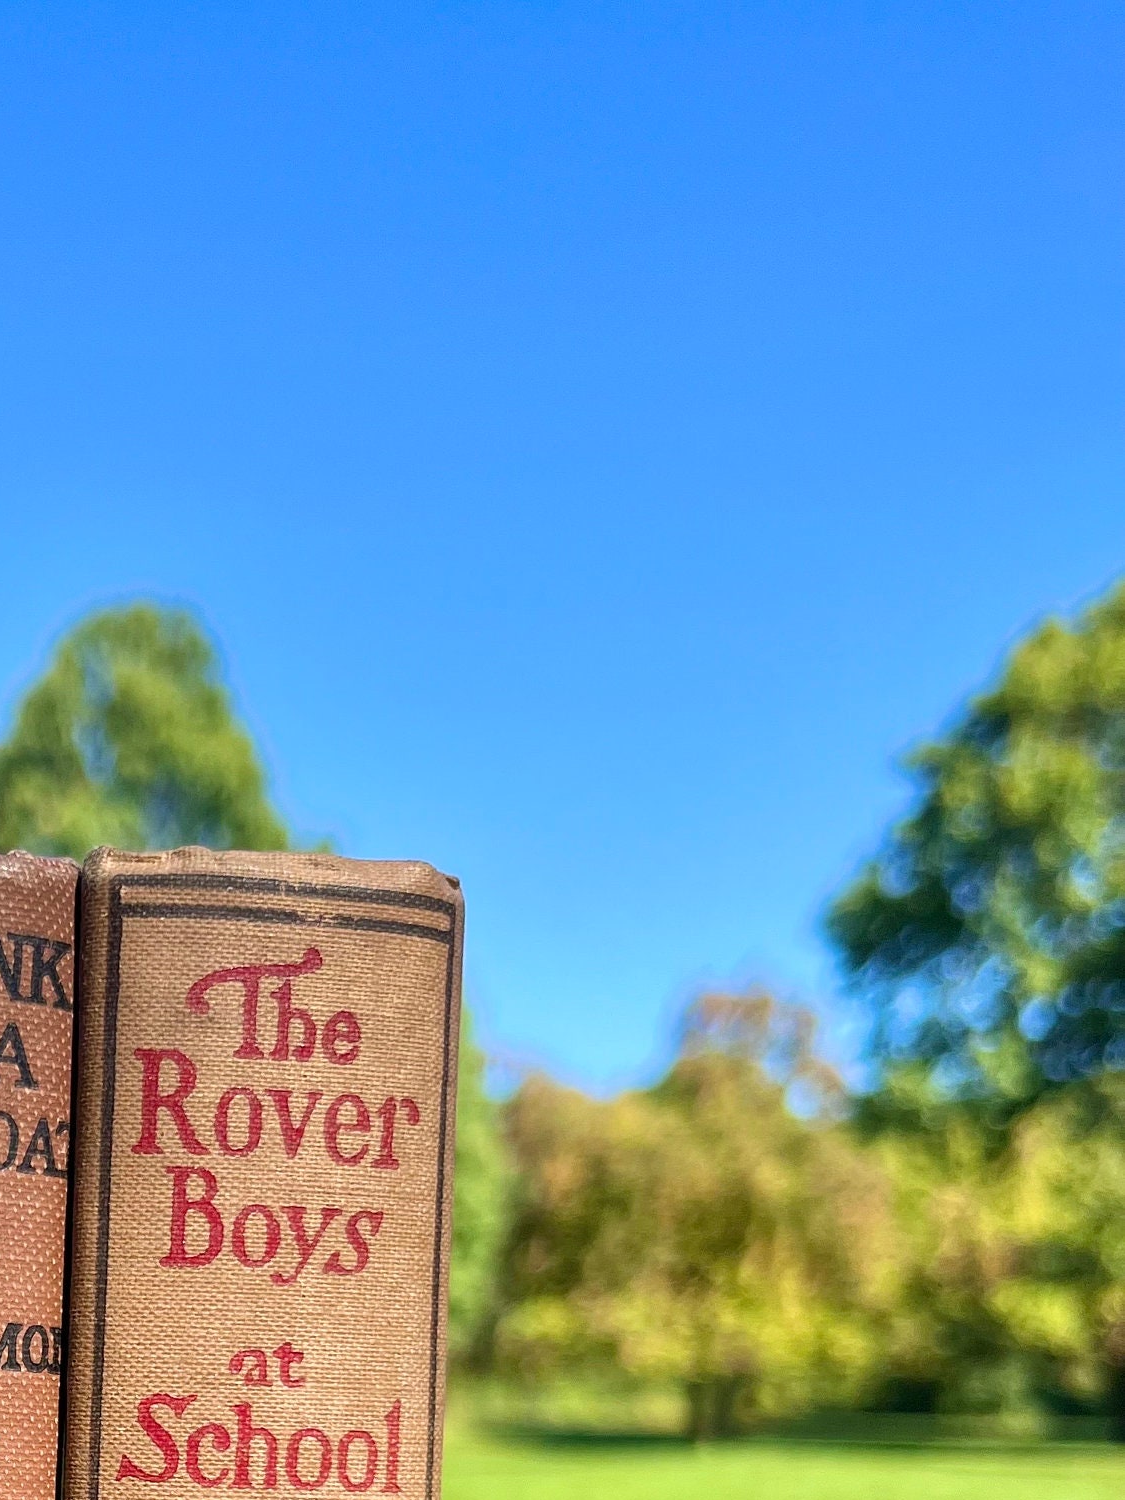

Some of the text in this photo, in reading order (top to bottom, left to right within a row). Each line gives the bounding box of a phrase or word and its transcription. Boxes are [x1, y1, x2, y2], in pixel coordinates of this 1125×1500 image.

[185, 946, 362, 1066] The
[130, 1046, 421, 1170] Rover
[159, 1165, 385, 1286] Boys
[228, 1341, 307, 1388] at
[115, 1392, 402, 1493] School
